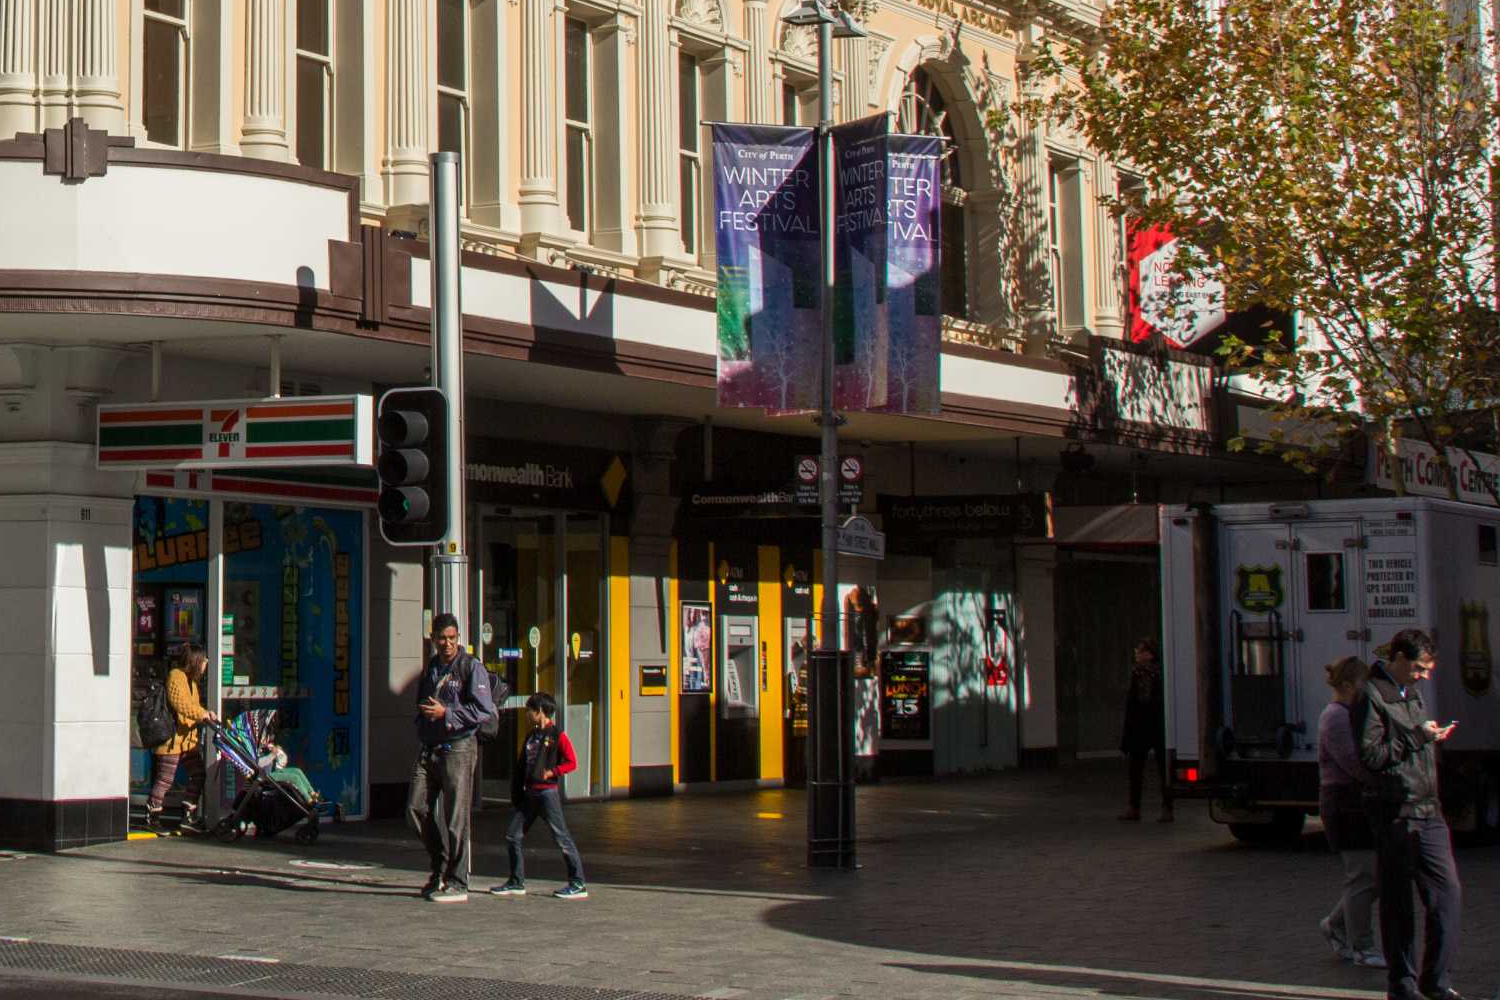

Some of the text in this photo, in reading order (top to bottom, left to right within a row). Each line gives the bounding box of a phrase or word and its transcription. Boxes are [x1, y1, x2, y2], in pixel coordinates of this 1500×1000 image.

[961, 3, 1015, 38] ARCADE
[759, 152, 768, 161] of
[724, 165, 809, 189] WINTER
[889, 176, 931, 198] TER
[739, 189, 796, 211] ARTS
[846, 184, 876, 208] ARTS
[887, 199, 917, 220] RTS
[720, 211, 819, 234] FESTIVAL
[836, 207, 885, 233] FSTIVA
[1154, 275, 1205, 289] LEING
[209, 432, 240, 443] ELEVEN
[132, 520, 261, 572] LURPEE
[450, 543, 457, 553] 9
[1368, 559, 1412, 569] THIS VEHICLE
[1367, 571, 1404, 581] PROTECTED
[1366, 583, 1415, 593] GPS SATELLITE
[1382, 595, 1409, 605] CAMERA
[1368, 608, 1415, 618] SURVEILLANCE
